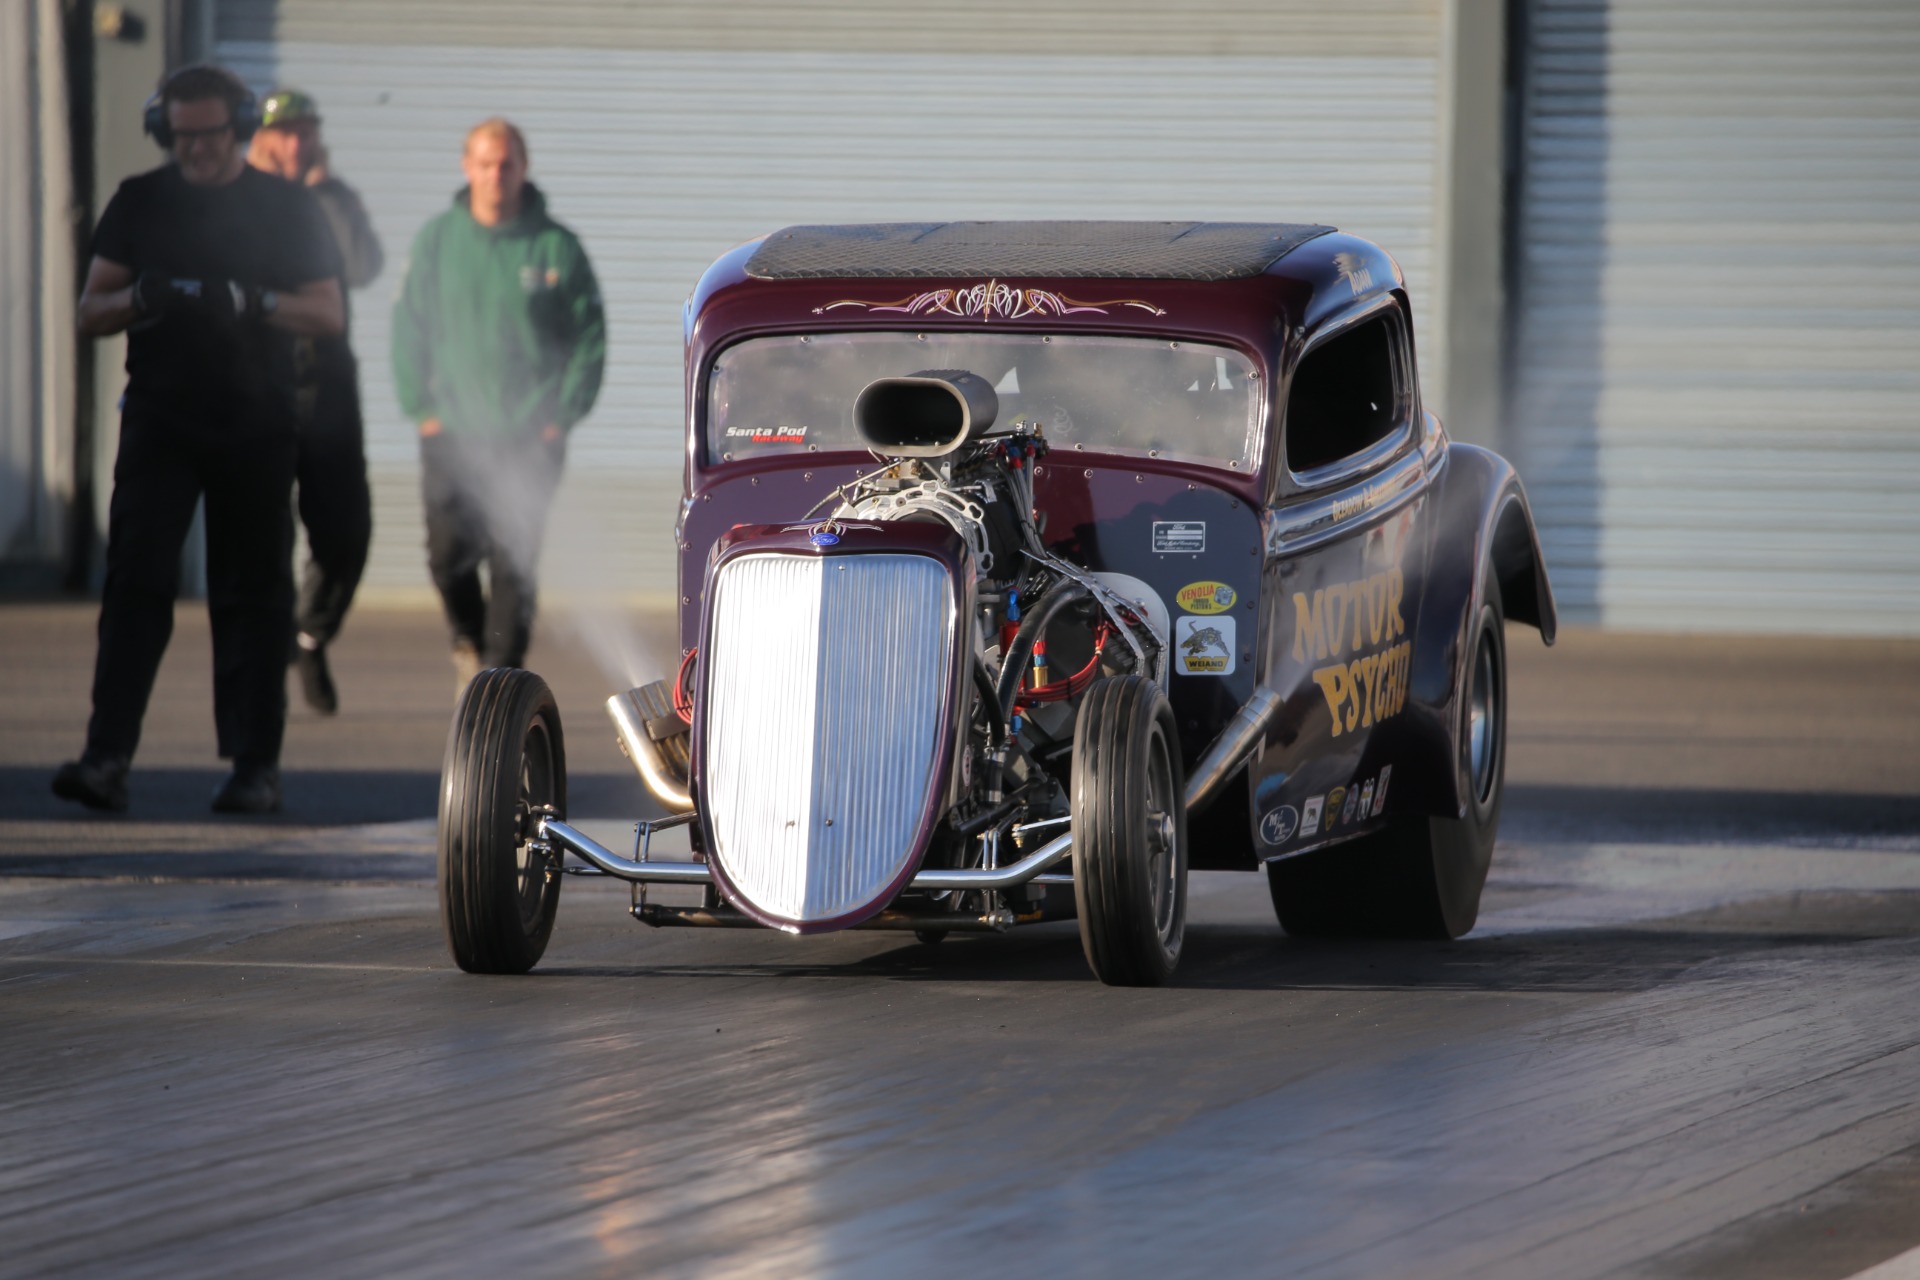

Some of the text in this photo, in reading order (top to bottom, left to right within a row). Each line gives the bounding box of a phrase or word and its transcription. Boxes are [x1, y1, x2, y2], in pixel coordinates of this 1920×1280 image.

[725, 425, 808, 437] Santa Pod
[751, 435, 804, 444] Raceway
[1181, 584, 1215, 601] VENOLIA
[1292, 568, 1405, 663] MOTOR
[1188, 660, 1224, 668] WEIAND
[1312, 639, 1411, 738] PSYCHO
